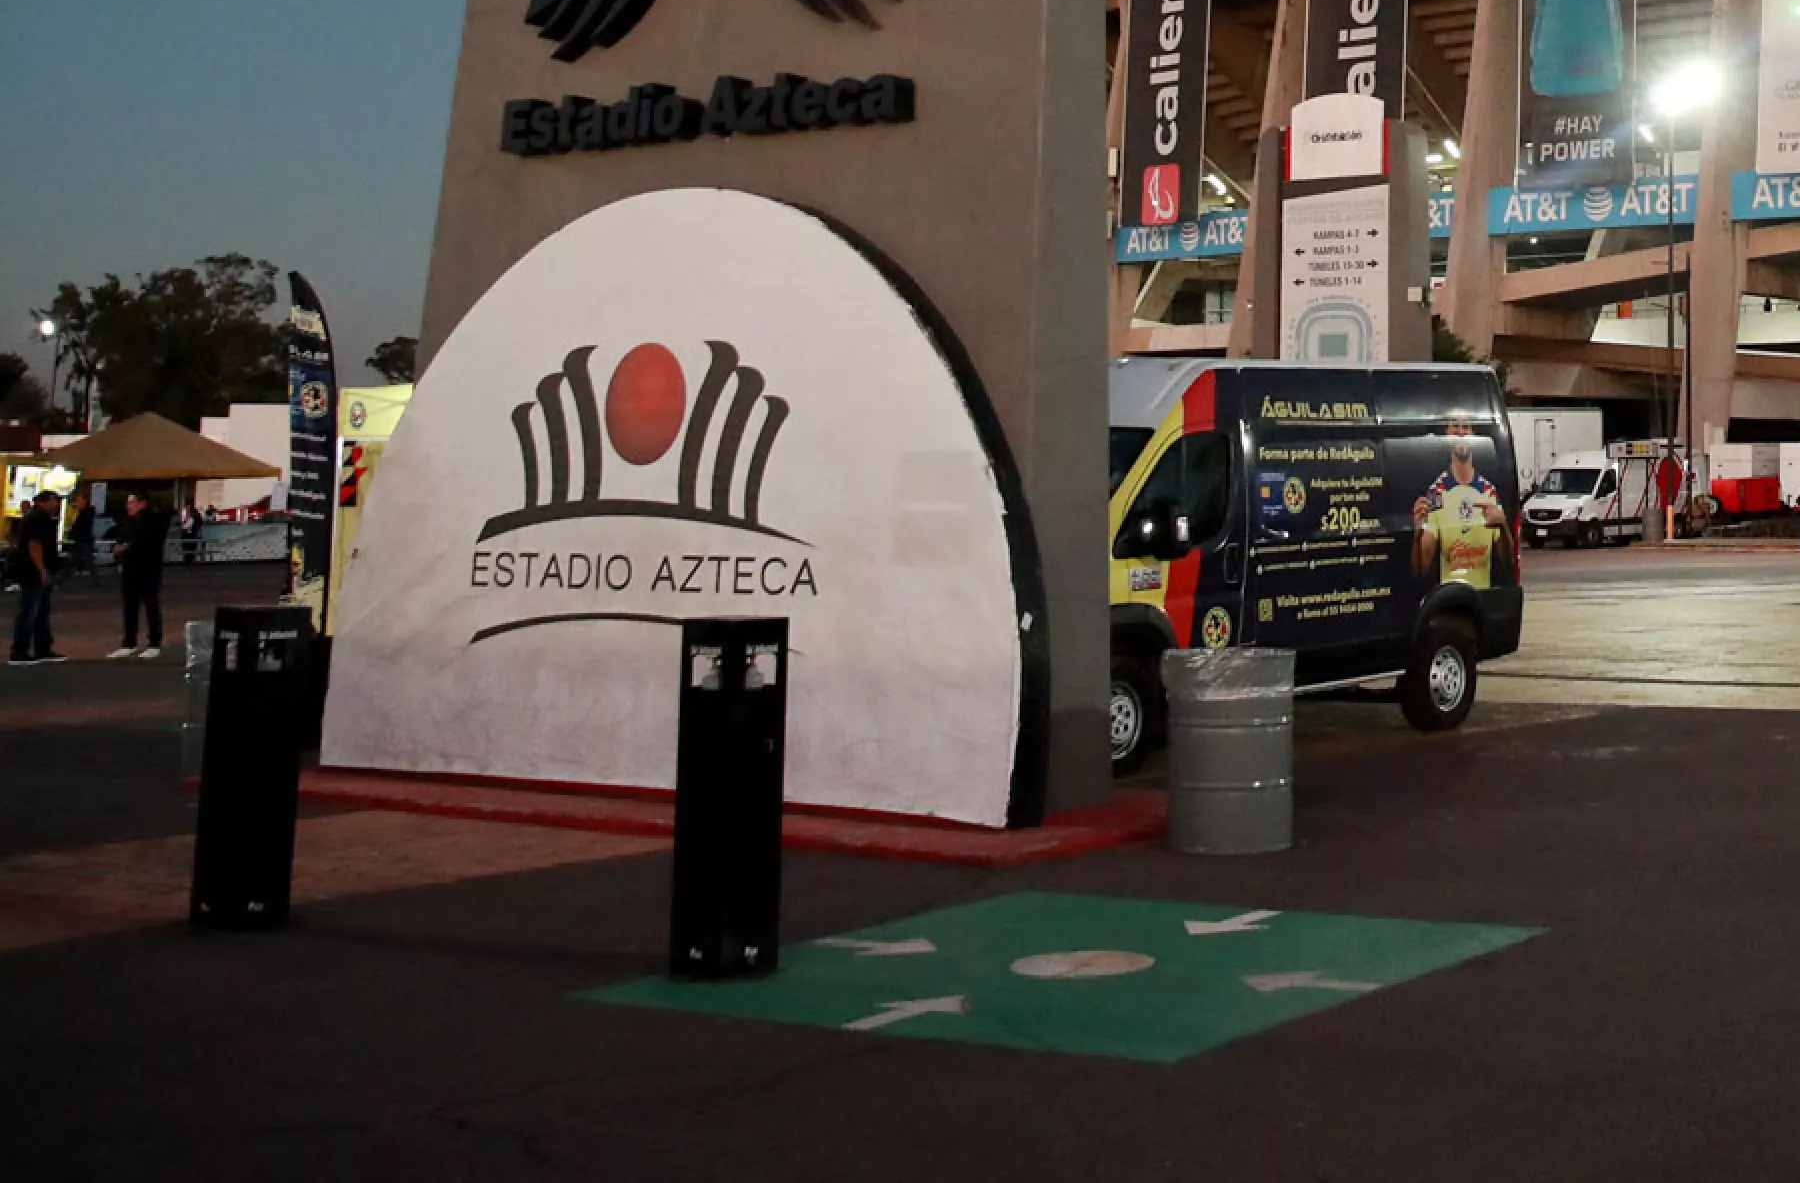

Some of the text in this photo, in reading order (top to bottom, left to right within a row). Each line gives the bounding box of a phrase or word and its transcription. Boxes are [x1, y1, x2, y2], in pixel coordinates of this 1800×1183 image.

[503, 74, 908, 155] Estadio Azteca
[1554, 114, 1604, 136] #HAY
[1539, 137, 1616, 162] POWER
[1503, 181, 1696, 224] AT&T AT&T
[1126, 216, 1247, 254] AT&T AT&
[470, 551, 819, 597] ESTADIO AZTECA
